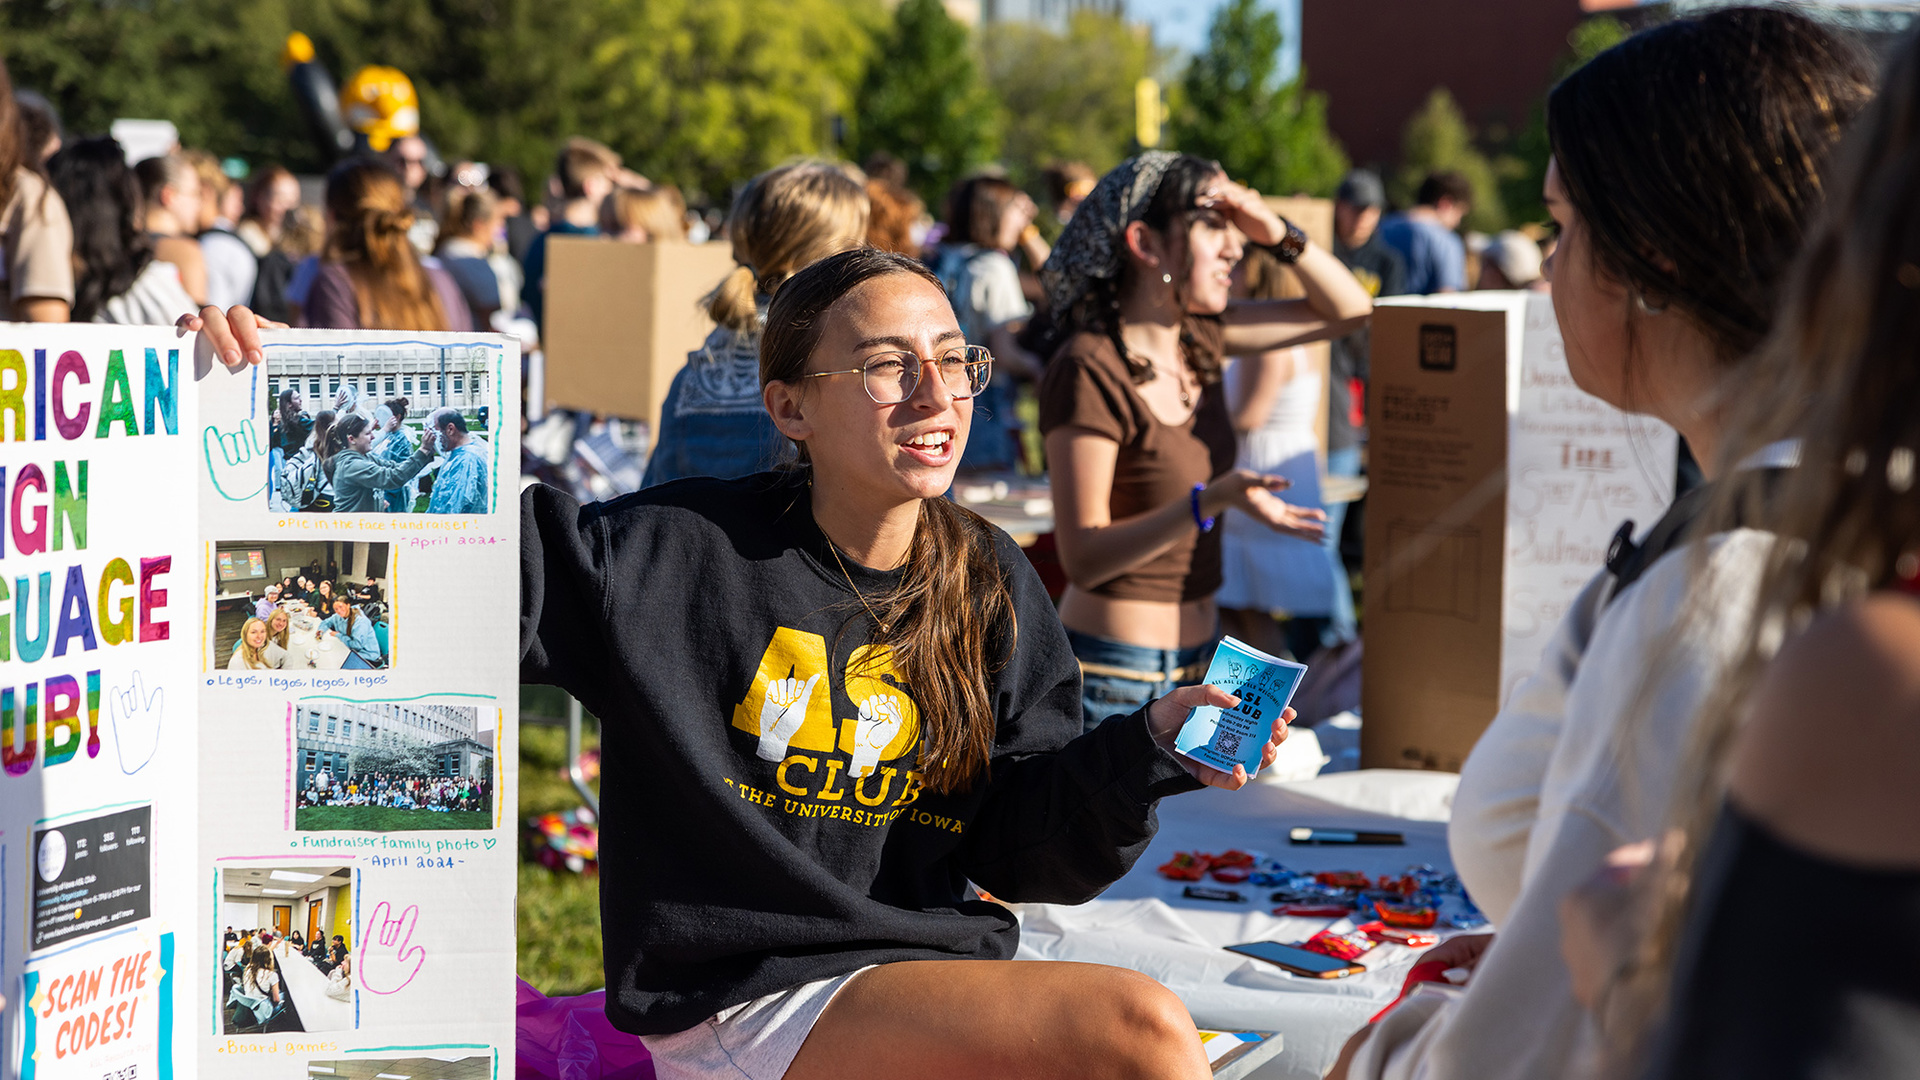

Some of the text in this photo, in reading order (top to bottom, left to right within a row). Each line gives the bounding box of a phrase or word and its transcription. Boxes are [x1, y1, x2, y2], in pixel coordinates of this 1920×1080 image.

[315, 518, 328, 529] in
[332, 518, 354, 529] the
[359, 519, 385, 531] face
[0, 555, 172, 663] UAGE
[269, 677, 307, 691] legos,
[311, 677, 350, 691] legos,
[354, 675, 388, 688] legos
[732, 626, 949, 768] AS
[1232, 689, 1262, 706] ASL
[0, 669, 101, 777] UB!
[1231, 702, 1263, 719] LUB
[776, 755, 926, 806] CLUB
[739, 783, 776, 807] THE
[784, 799, 890, 827] UNIVERSITY
[910, 808, 963, 834] IOWA
[303, 836, 479, 855] Fundraiser family photo
[42, 950, 152, 1019] SCAN THE
[55, 996, 138, 1060] CODES!
[227, 1040, 338, 1056] Board games
